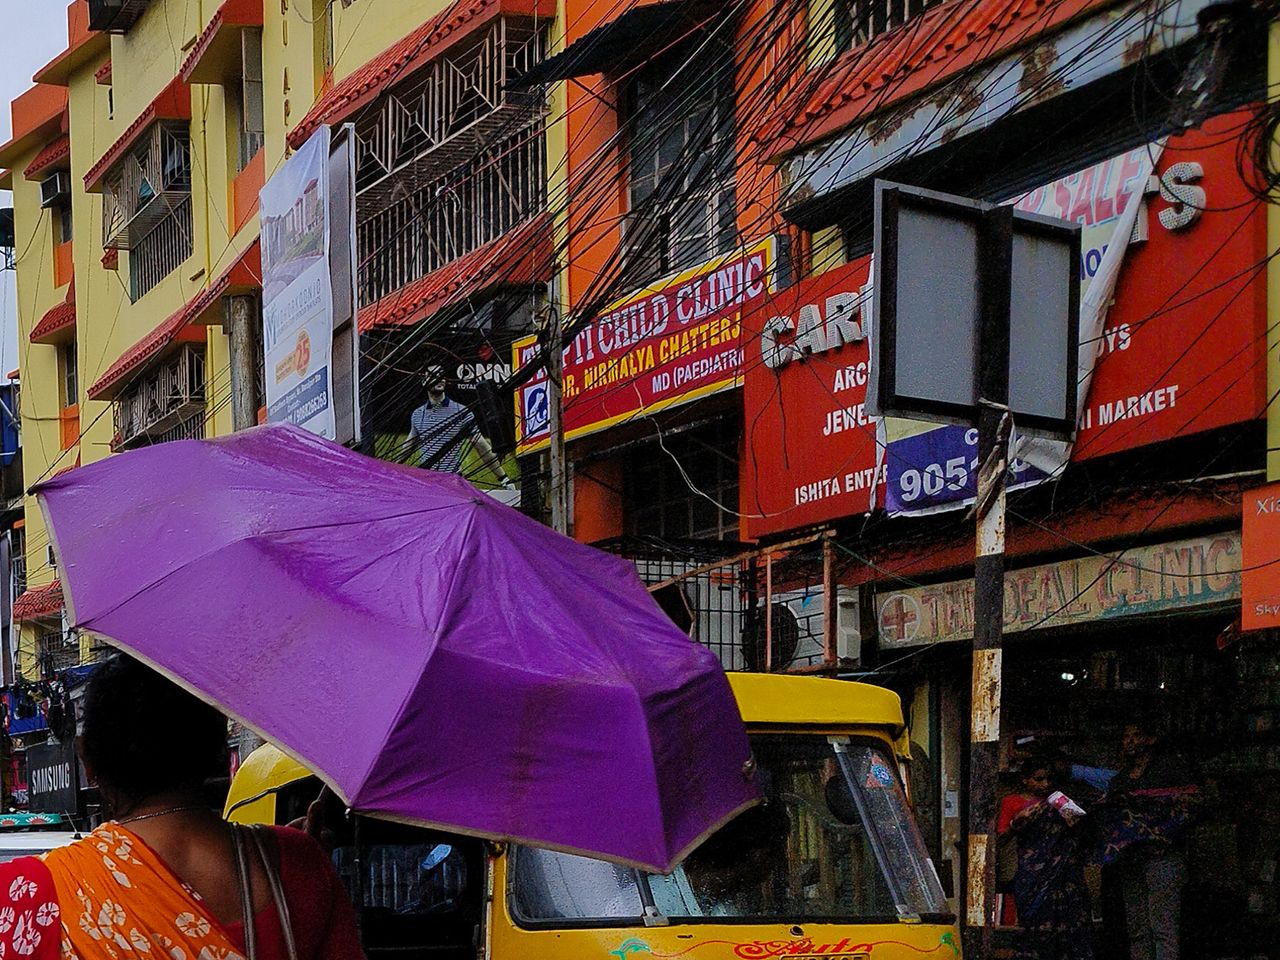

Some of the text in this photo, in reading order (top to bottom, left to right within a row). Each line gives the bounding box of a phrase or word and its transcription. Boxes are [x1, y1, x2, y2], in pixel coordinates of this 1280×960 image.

[598, 294, 669, 354] CHILD
[676, 255, 763, 324] CLINIC
[1098, 323, 1131, 356] YS
[584, 345, 654, 391] NIRMALYA
[652, 368, 670, 393] MD
[1099, 385, 1179, 426] MARKET
[795, 477, 841, 505] ISHITA
[1098, 538, 1235, 606] CLINIC
[32, 762, 70, 795] SAMSUNG
